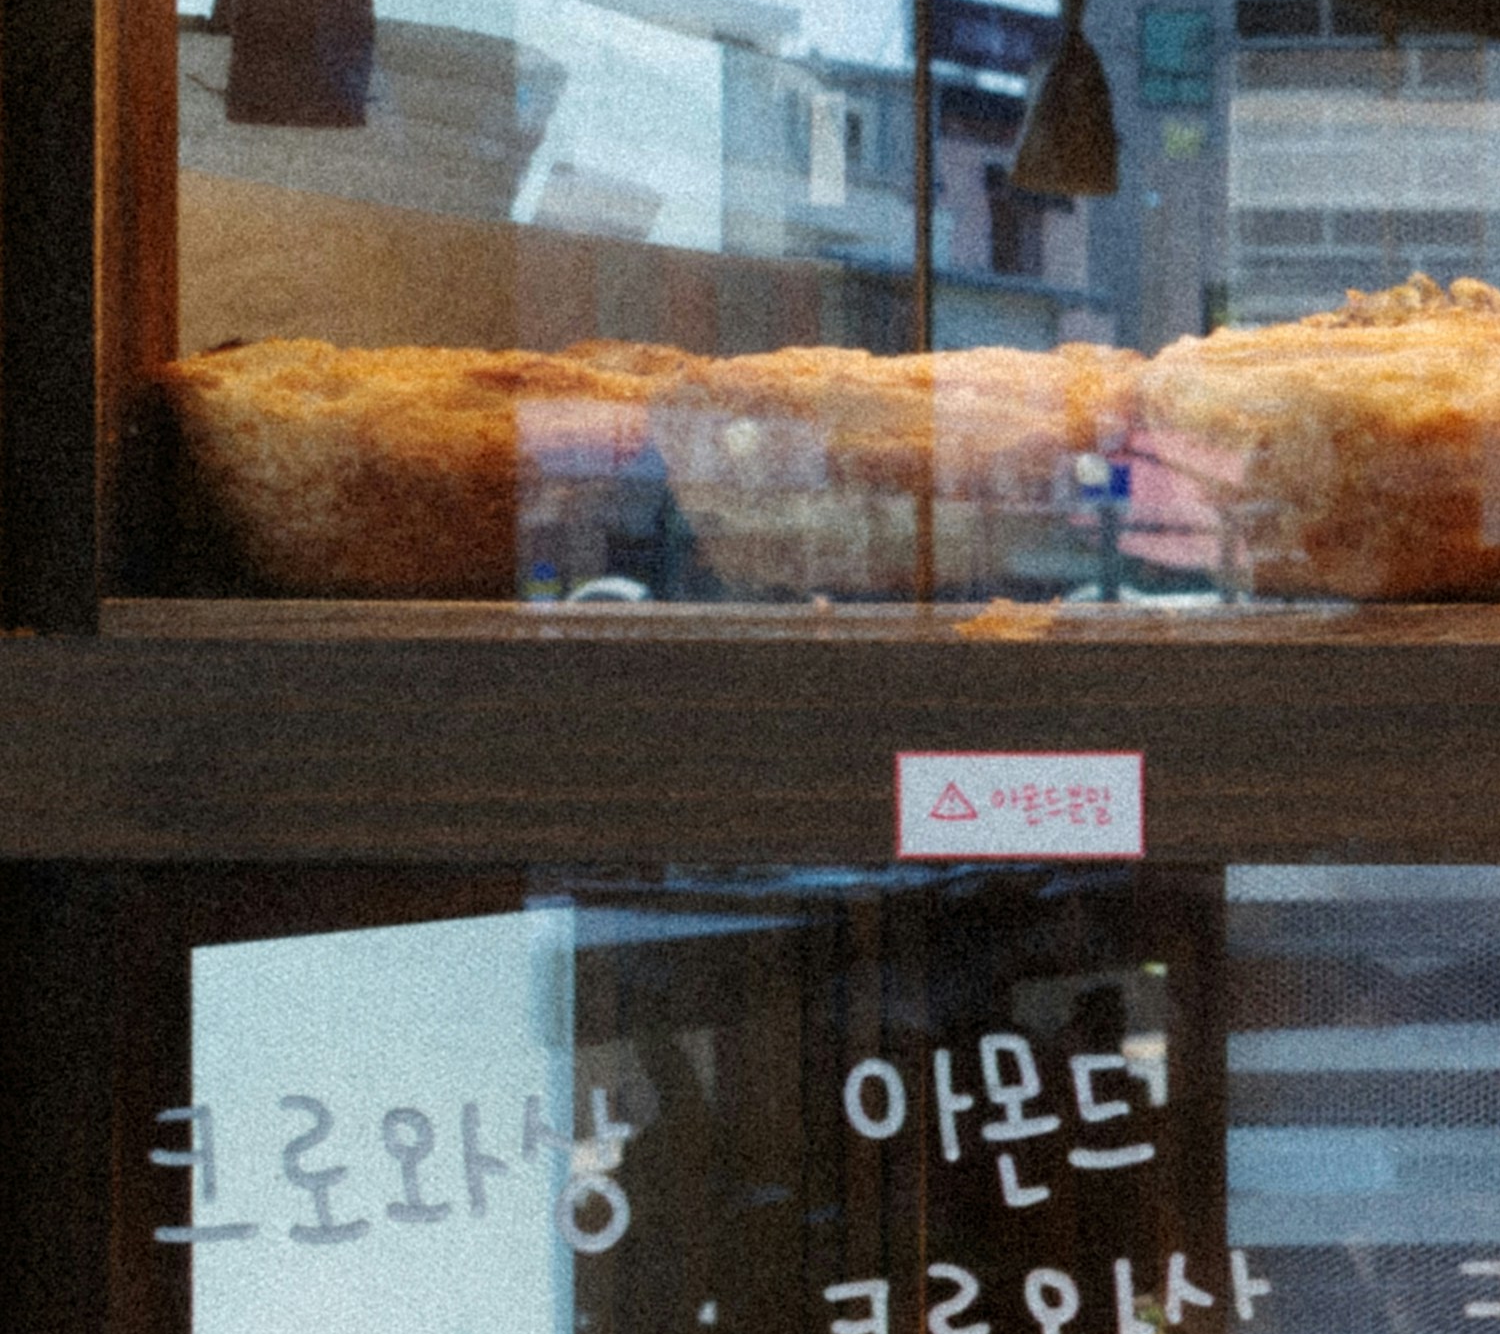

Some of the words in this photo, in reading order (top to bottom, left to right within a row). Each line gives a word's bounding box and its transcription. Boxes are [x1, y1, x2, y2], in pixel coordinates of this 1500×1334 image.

[990, 781, 1113, 827] 아몬드분말
[150, 1087, 634, 1253] 크로와상
[842, 1031, 1170, 1209] 아몬드
